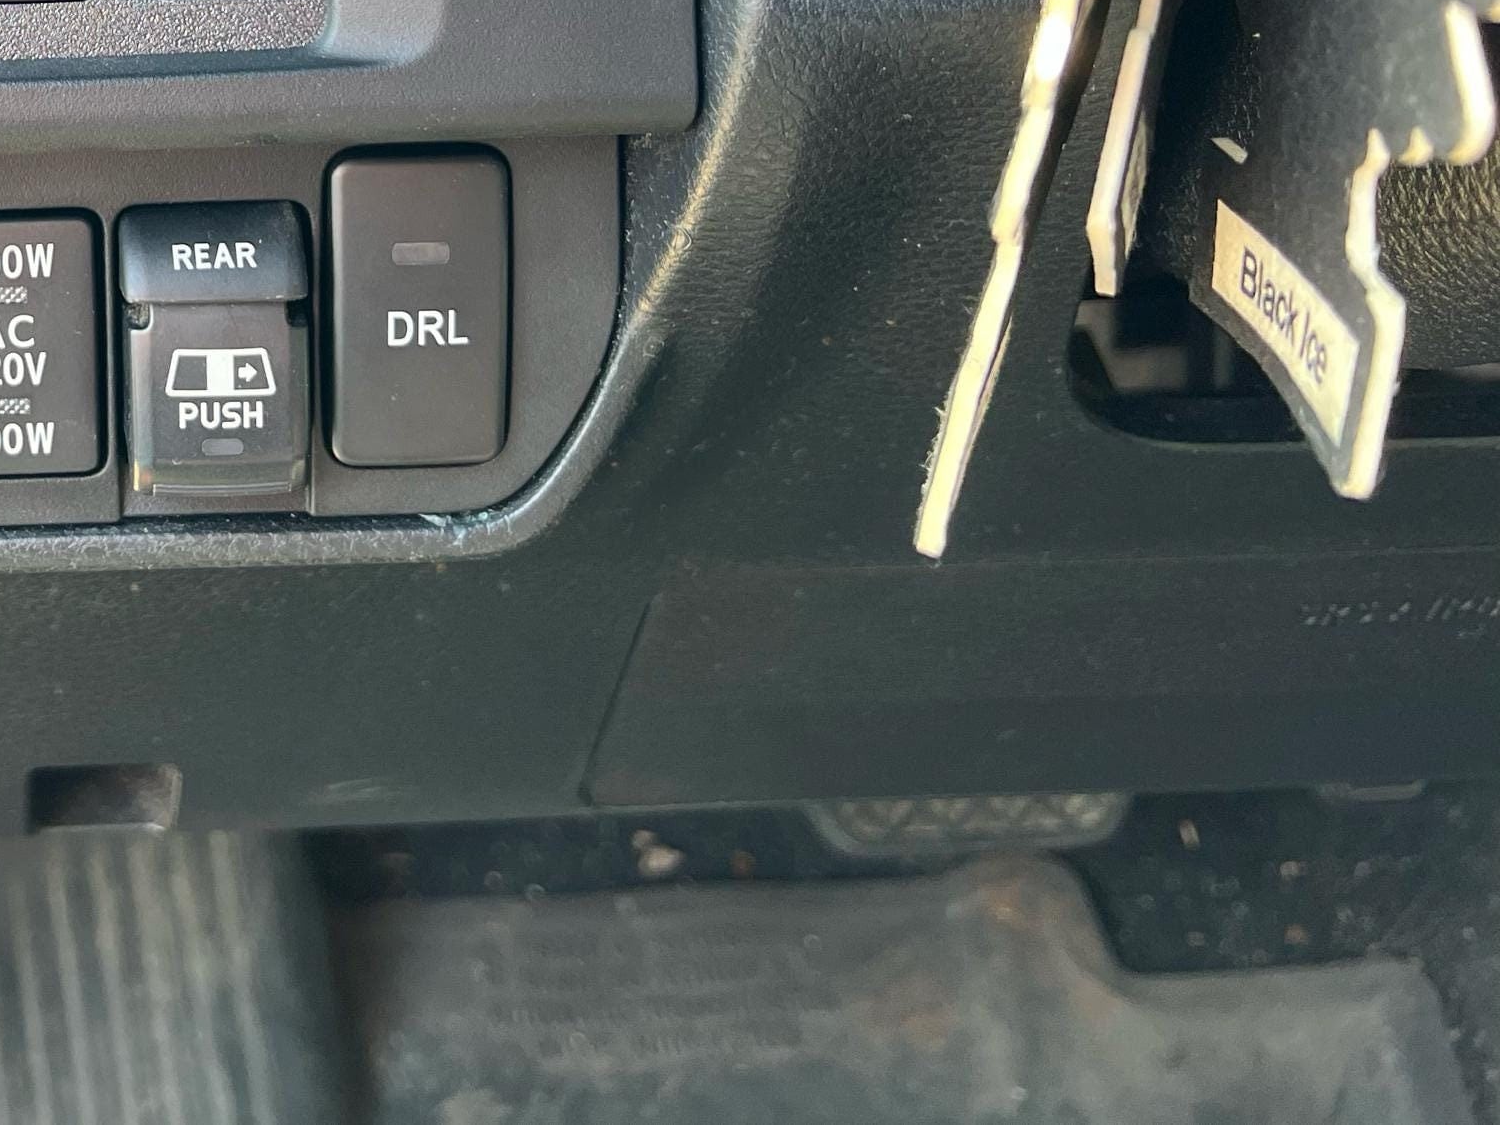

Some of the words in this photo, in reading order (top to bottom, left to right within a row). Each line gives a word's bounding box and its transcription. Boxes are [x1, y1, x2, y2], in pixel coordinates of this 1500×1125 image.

[171, 241, 258, 270] REAR
[386, 309, 470, 348] DRL
[1239, 245, 1298, 346] Black
[1299, 309, 1328, 385] Ice
[178, 401, 264, 430] PUSH
